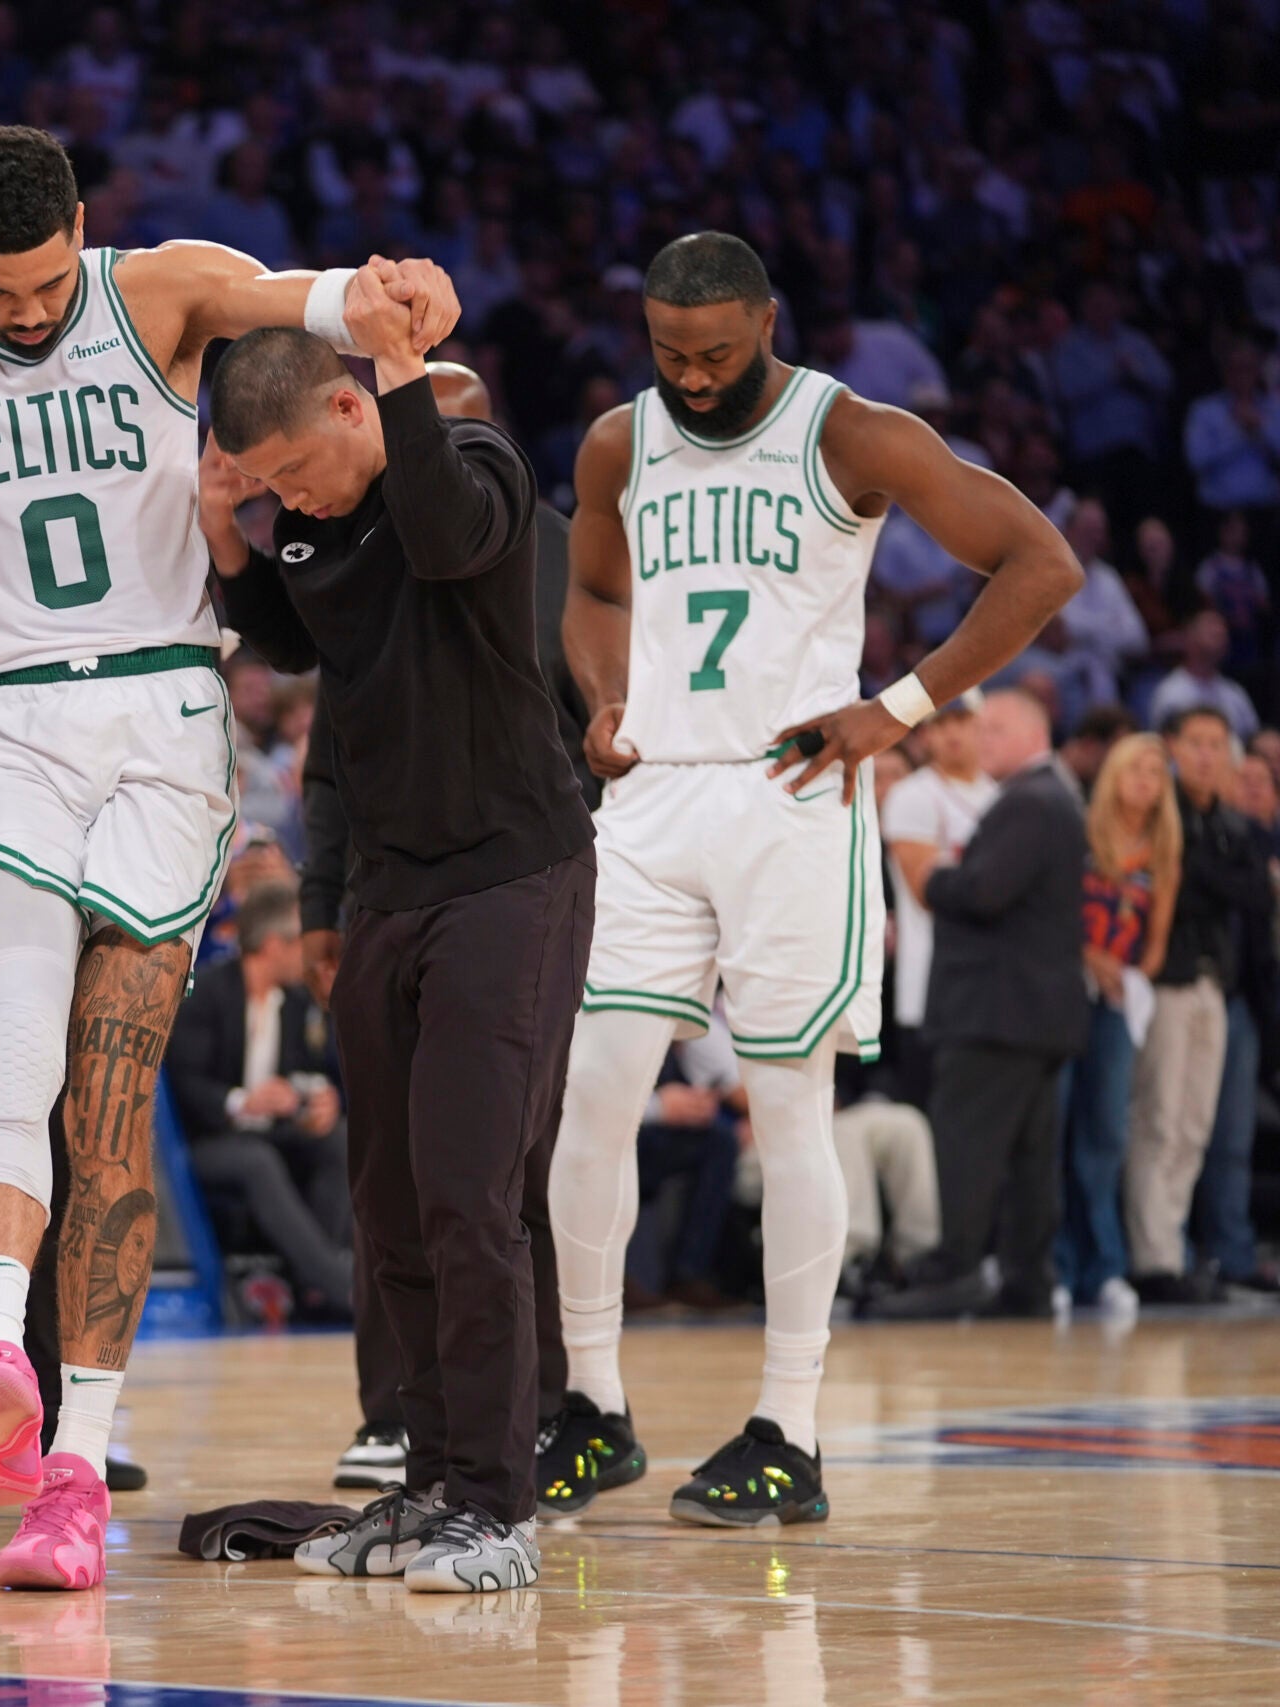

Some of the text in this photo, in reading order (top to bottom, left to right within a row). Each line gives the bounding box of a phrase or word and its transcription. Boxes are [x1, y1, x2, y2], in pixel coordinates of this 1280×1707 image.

[68, 337, 120, 360] Amica
[748, 448, 799, 464] Amica
[20, 493, 112, 609] 0
[638, 486, 803, 581] CELTICS
[687, 590, 749, 692] 7
[74, 1053, 140, 1162] 98
